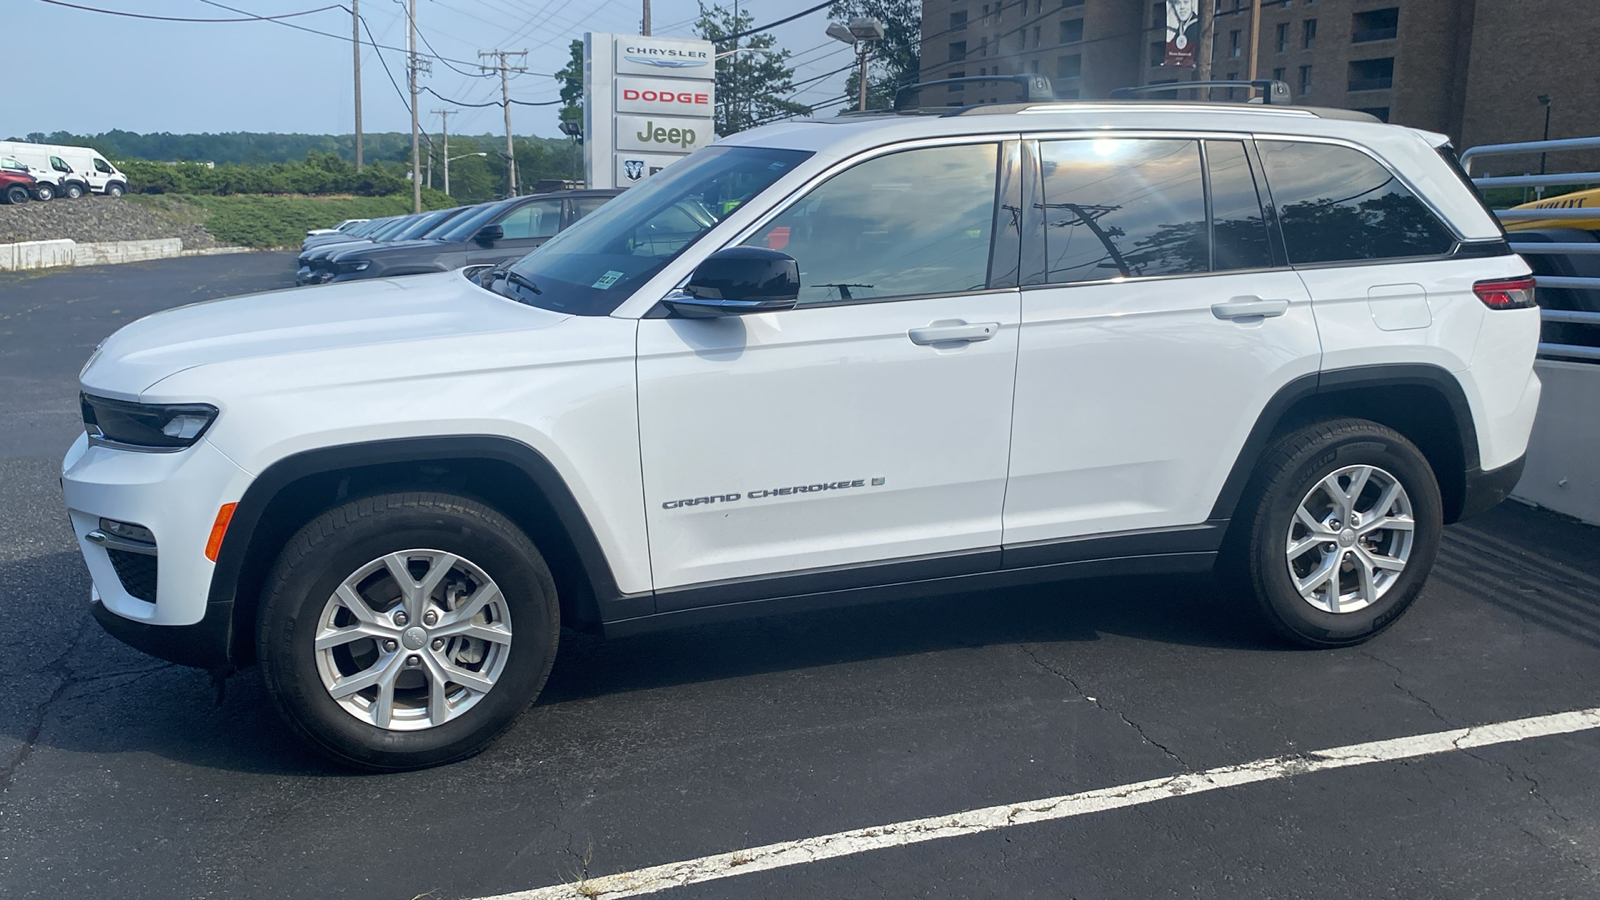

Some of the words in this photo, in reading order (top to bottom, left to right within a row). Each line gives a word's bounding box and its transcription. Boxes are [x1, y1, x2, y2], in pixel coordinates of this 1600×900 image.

[626, 47, 707, 58] CHRYSLER
[623, 89, 708, 104] DODGE
[637, 121, 696, 148] Jeep
[662, 492, 741, 510] GRAND
[747, 479, 865, 499] CHEROKEE
